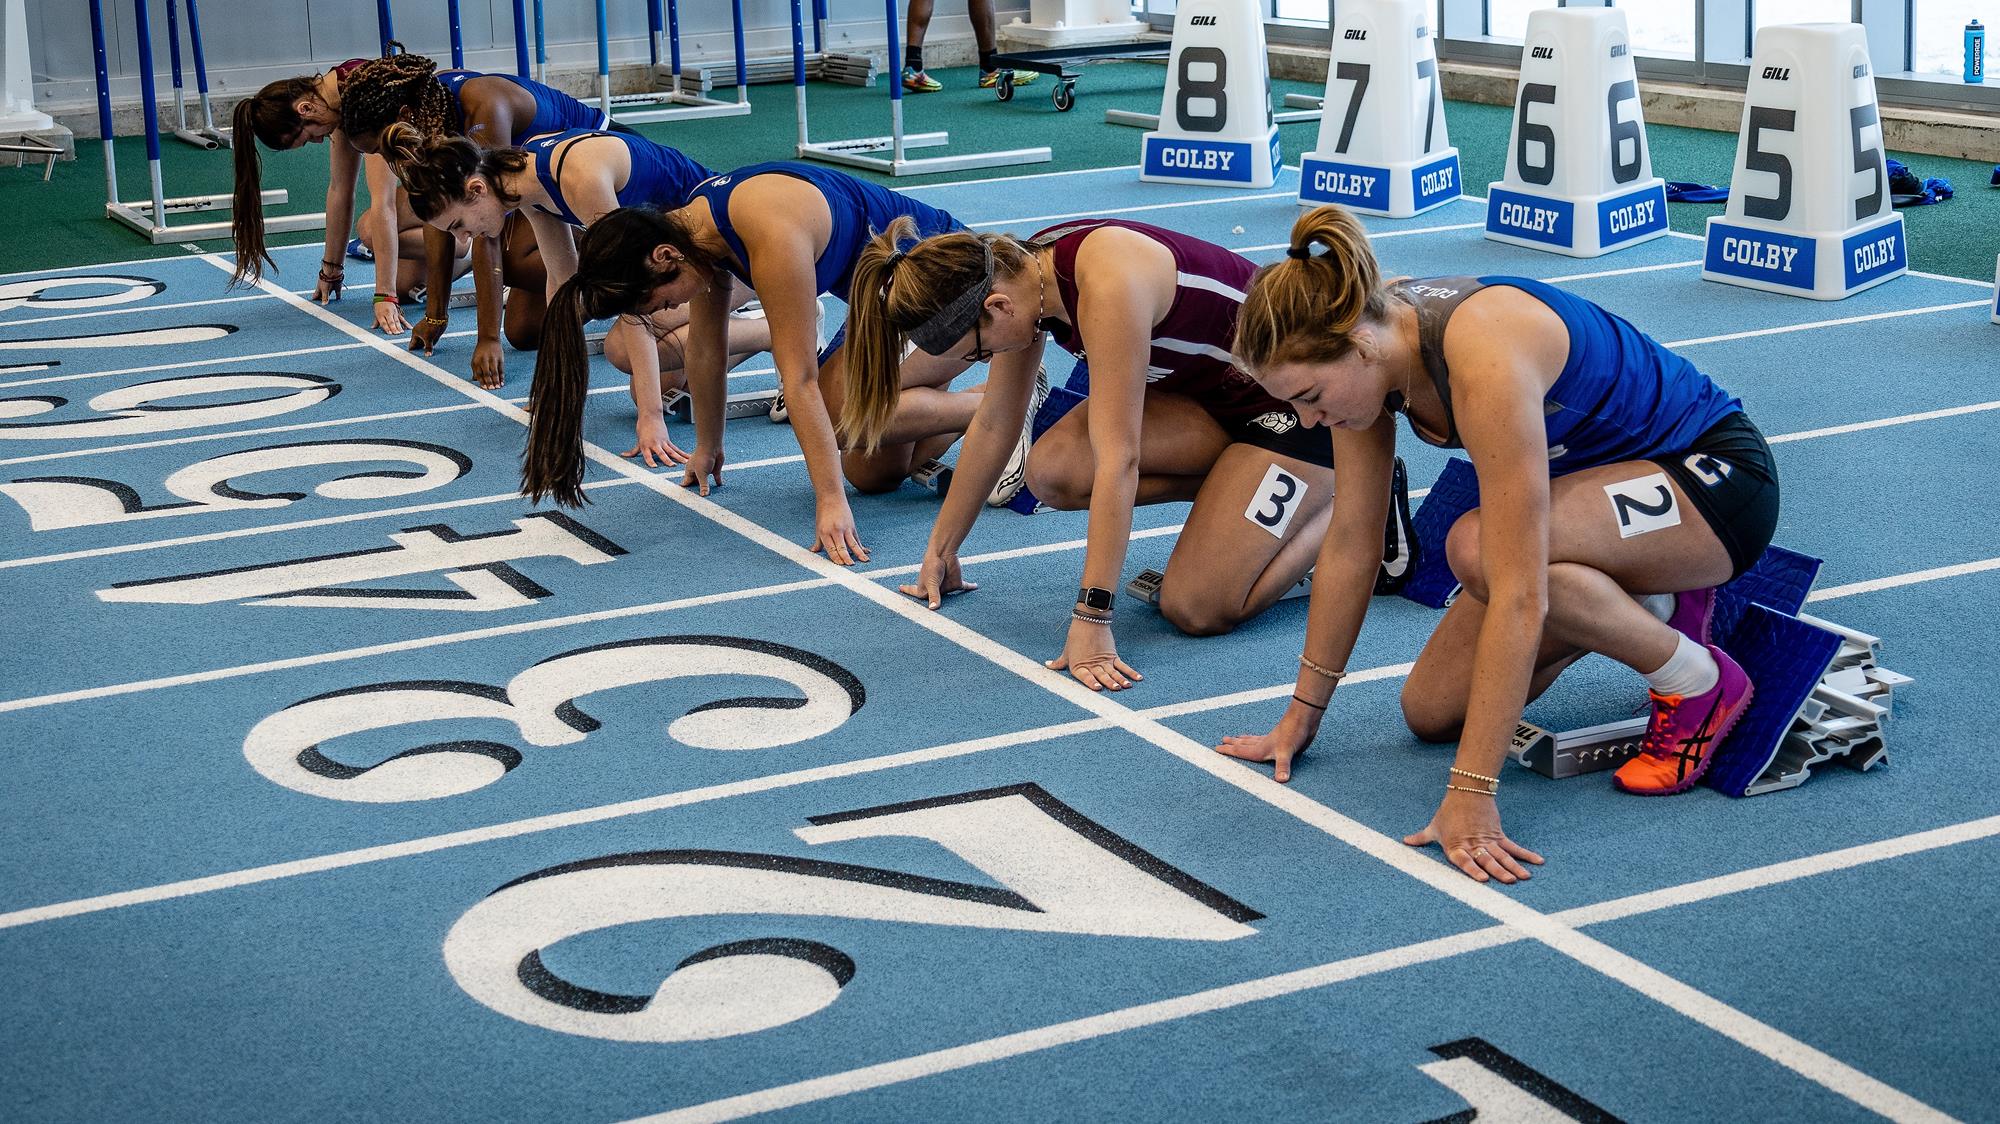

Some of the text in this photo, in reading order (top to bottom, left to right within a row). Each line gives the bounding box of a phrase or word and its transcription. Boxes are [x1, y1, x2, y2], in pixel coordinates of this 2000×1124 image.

[1190, 15, 1217, 26] GILL
[1344, 29, 1367, 41] GILL
[1531, 46, 1554, 60] GILL
[1610, 43, 1627, 58] GILL
[1973, 38, 1981, 76] POWERADE
[1176, 46, 1228, 132] 8
[1761, 66, 1791, 81] GILL
[1852, 63, 1868, 79] GILL
[1335, 61, 1371, 154] 7
[1416, 59, 1436, 154] 7
[1516, 82, 1556, 186] 6
[1608, 80, 1642, 185] 6
[1162, 147, 1235, 171] COLBY
[1744, 106, 1796, 221] 5
[1850, 103, 1883, 221] 5
[1314, 170, 1376, 198] COLBY
[1420, 166, 1454, 197] COLBY
[1499, 203, 1559, 235] COLBY
[1610, 199, 1656, 234] COLBY
[1723, 237, 1798, 272] COLBY
[1854, 235, 1896, 274] COLBY
[1409, 285, 1459, 299] COLB
[0, 438, 474, 532] 5
[1255, 473, 1297, 527] 3
[1612, 484, 1673, 527] 2
[95, 510, 629, 613] 4
[243, 634, 867, 804] 3
[1515, 724, 1539, 741] ILL
[442, 781, 1265, 1043] 2
